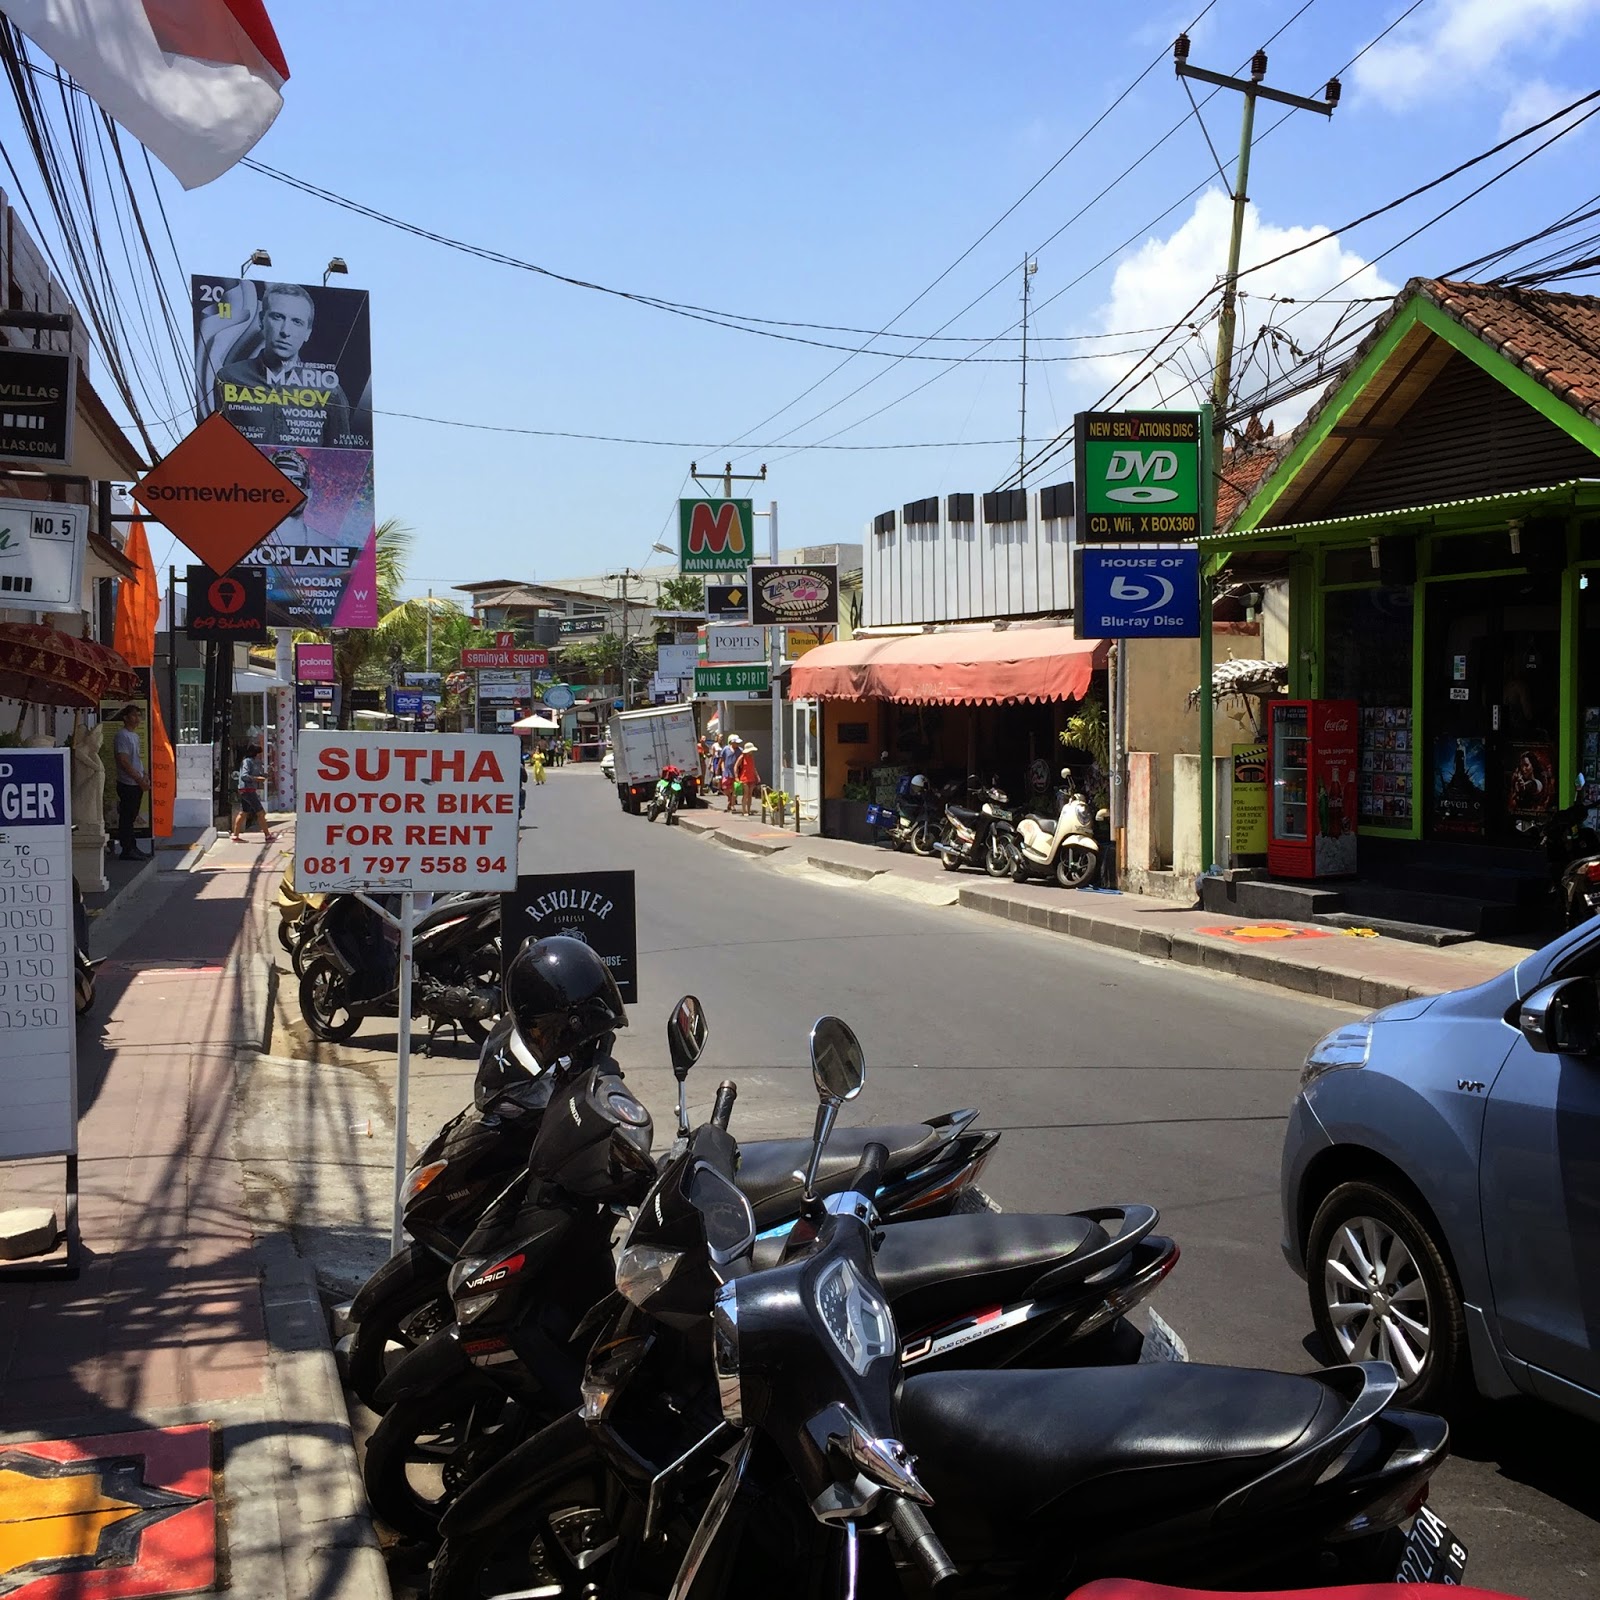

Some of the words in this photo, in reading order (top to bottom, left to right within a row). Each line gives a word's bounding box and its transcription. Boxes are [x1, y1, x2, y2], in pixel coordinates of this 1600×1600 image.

[199, 284, 225, 302] 20
[217, 302, 232, 319] 11
[266, 368, 339, 389] MARIO
[0, 384, 59, 398] VILLAS
[224, 384, 331, 407] BASANOV
[281, 408, 327, 419] WOOBAR
[286, 419, 324, 428] THURSDAY
[290, 428, 321, 436] 20/11/14
[1089, 422, 1111, 437] NEW
[1113, 418, 1171, 440] SENZATIONS
[1173, 423, 1194, 437] DISC
[279, 434, 318, 443] 10PM-4AM
[1105, 450, 1179, 484] DVD
[146, 482, 291, 504] somewhere.
[34, 517, 71, 535] NO.5
[1091, 517, 1111, 535] CD,
[1113, 517, 1135, 534] Wii,
[1140, 517, 1149, 531] X
[1151, 516, 1195, 532] BOX360
[242, 547, 349, 566] ROPLANE
[685, 558, 714, 569] MINI
[715, 558, 750, 569] MART
[1100, 559, 1157, 568] HOUSE
[1160, 559, 1184, 567] OF
[292, 577, 342, 588] WOOBAR
[757, 572, 780, 587] PIANO
[809, 571, 833, 586] MUSIC
[353, 590, 368, 600] W
[761, 602, 776, 613] BAR
[783, 602, 829, 616] RESTAURANT
[1101, 616, 1150, 628] Blu-ray
[1153, 615, 1184, 626] Disc
[715, 636, 760, 648] POPITS
[300, 658, 331, 667] paloma
[467, 652, 509, 665] seminyak
[512, 653, 545, 665] square
[697, 672, 721, 687] WINE
[725, 672, 732, 685] &
[736, 671, 765, 686] SPIRIT
[317, 748, 504, 782] SUTHA
[1, 783, 56, 820] GER
[305, 792, 426, 814] MOTOR
[437, 793, 514, 814] BIKE
[1440, 800, 1480, 809] revene
[326, 825, 393, 845] FOR
[405, 825, 493, 846] RENT
[14, 845, 30, 855] TC
[303, 856, 350, 874] 081
[363, 856, 411, 874] 797
[420, 856, 467, 874] 558
[476, 856, 507, 873] 94
[525, 889, 614, 922] REVOLVER
[554, 915, 585, 923] ESPRESSO
[569, 1096, 582, 1127] HONDA
[445, 1188, 471, 1201] YAMAHA
[654, 1192, 664, 1227] HONDA
[465, 1269, 506, 1289] VARIO
[933, 1341, 954, 1353] LIQUID
[955, 1331, 982, 1345] COOLED
[1449, 1542, 1466, 1569] 19
